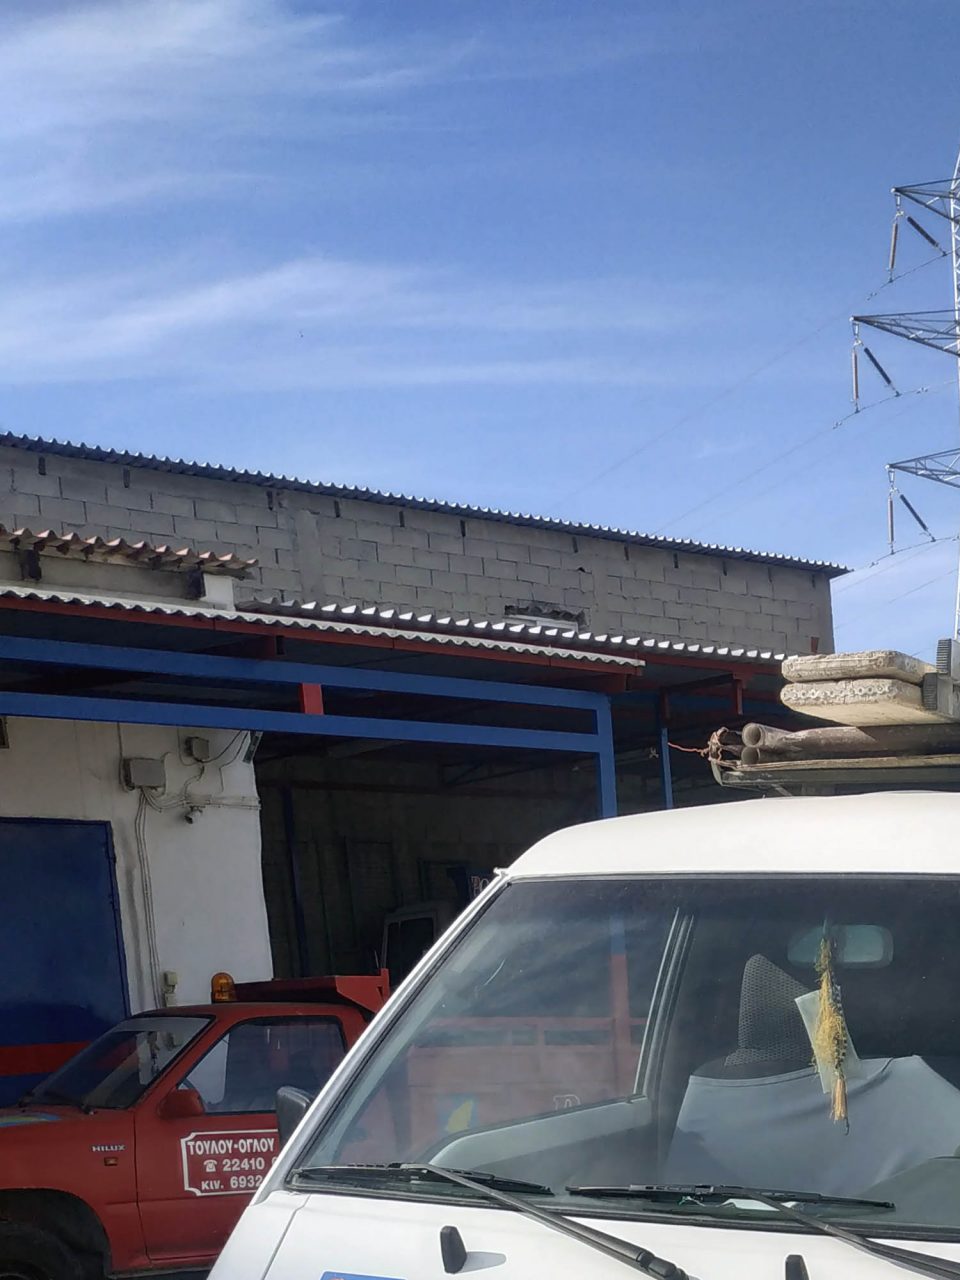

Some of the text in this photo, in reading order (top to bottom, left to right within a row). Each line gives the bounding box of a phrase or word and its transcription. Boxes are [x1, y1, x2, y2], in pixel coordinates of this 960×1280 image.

[92, 1144, 127, 1152] HILUX
[187, 1137, 275, 1156] ΤΟΥΛΟΥ-ΟΓΛΟΥ
[222, 1157, 266, 1172] 22410
[230, 1175, 263, 1188] 6932
